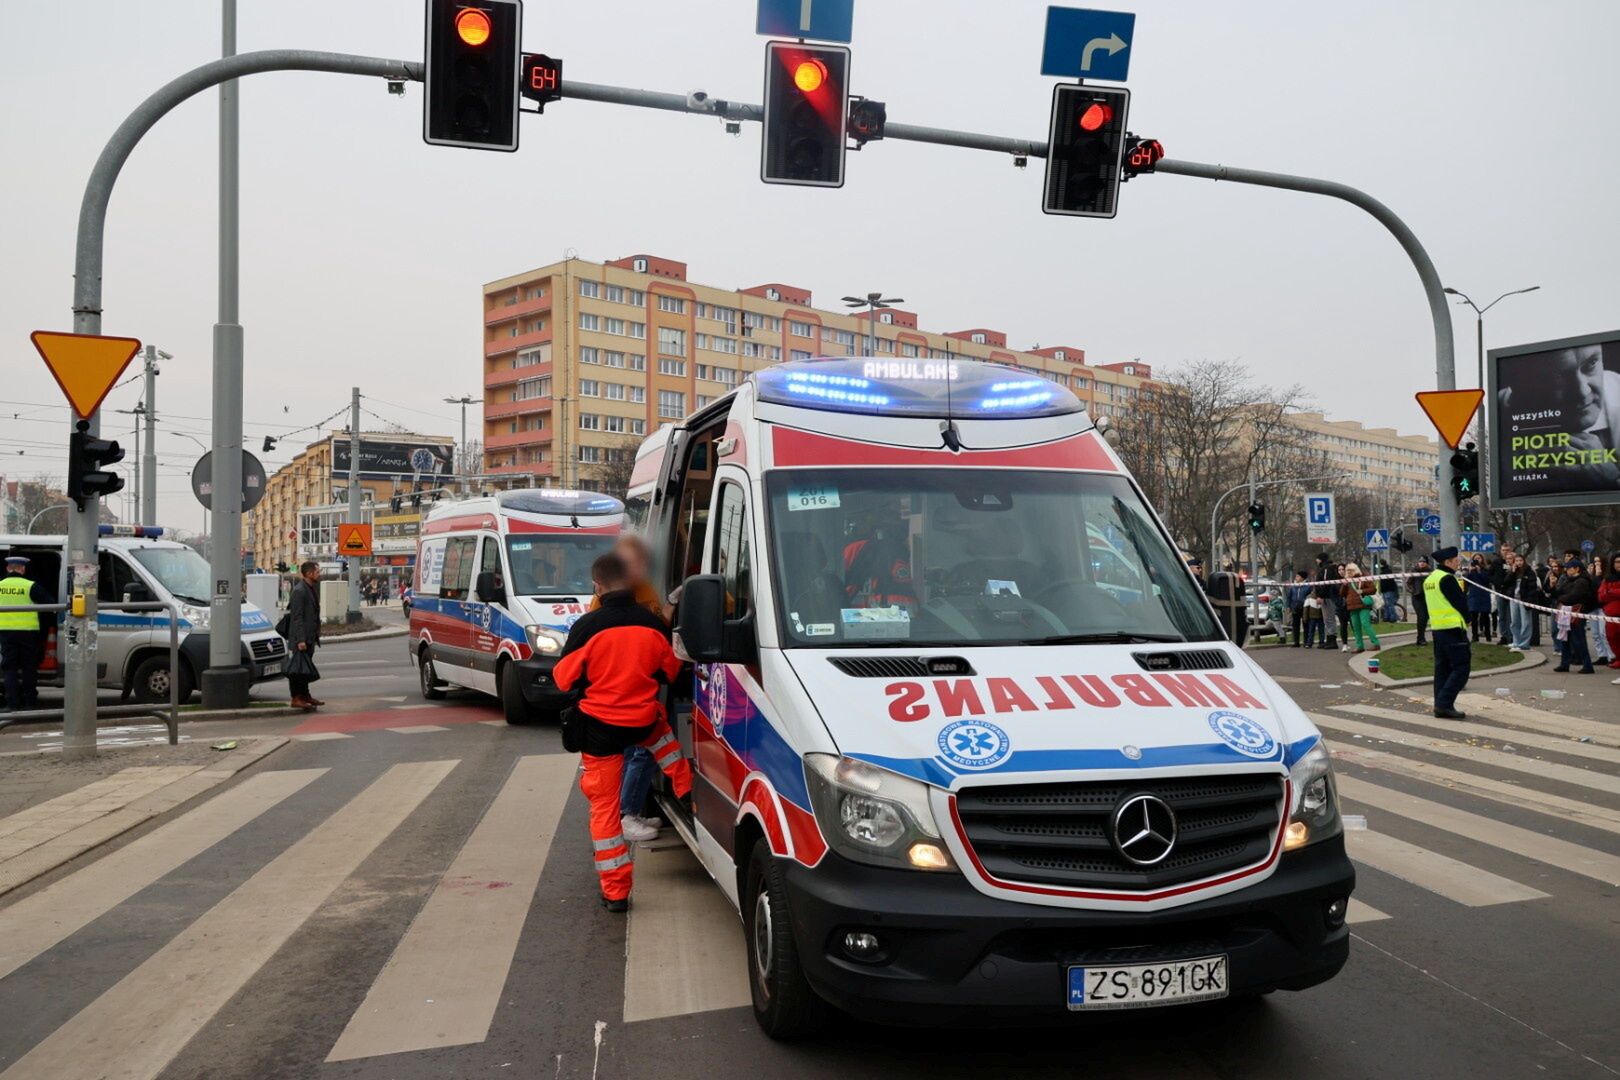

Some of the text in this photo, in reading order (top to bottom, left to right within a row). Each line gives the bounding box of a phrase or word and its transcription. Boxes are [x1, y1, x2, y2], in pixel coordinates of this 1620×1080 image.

[532, 66, 556, 89] 64
[863, 362, 959, 380] AMBULANS
[1512, 409, 1562, 421] wszystko
[1512, 432, 1571, 451] PIOTR
[1512, 448, 1618, 470] KRZYSTEK
[1513, 473, 1548, 482] KSIĄŻKA
[801, 495, 827, 506] 016
[1313, 500, 1326, 521] P
[0, 588, 25, 596] OLICJA
[1089, 957, 1224, 1000] ZS 891GK
[1072, 990, 1083, 998] PL
